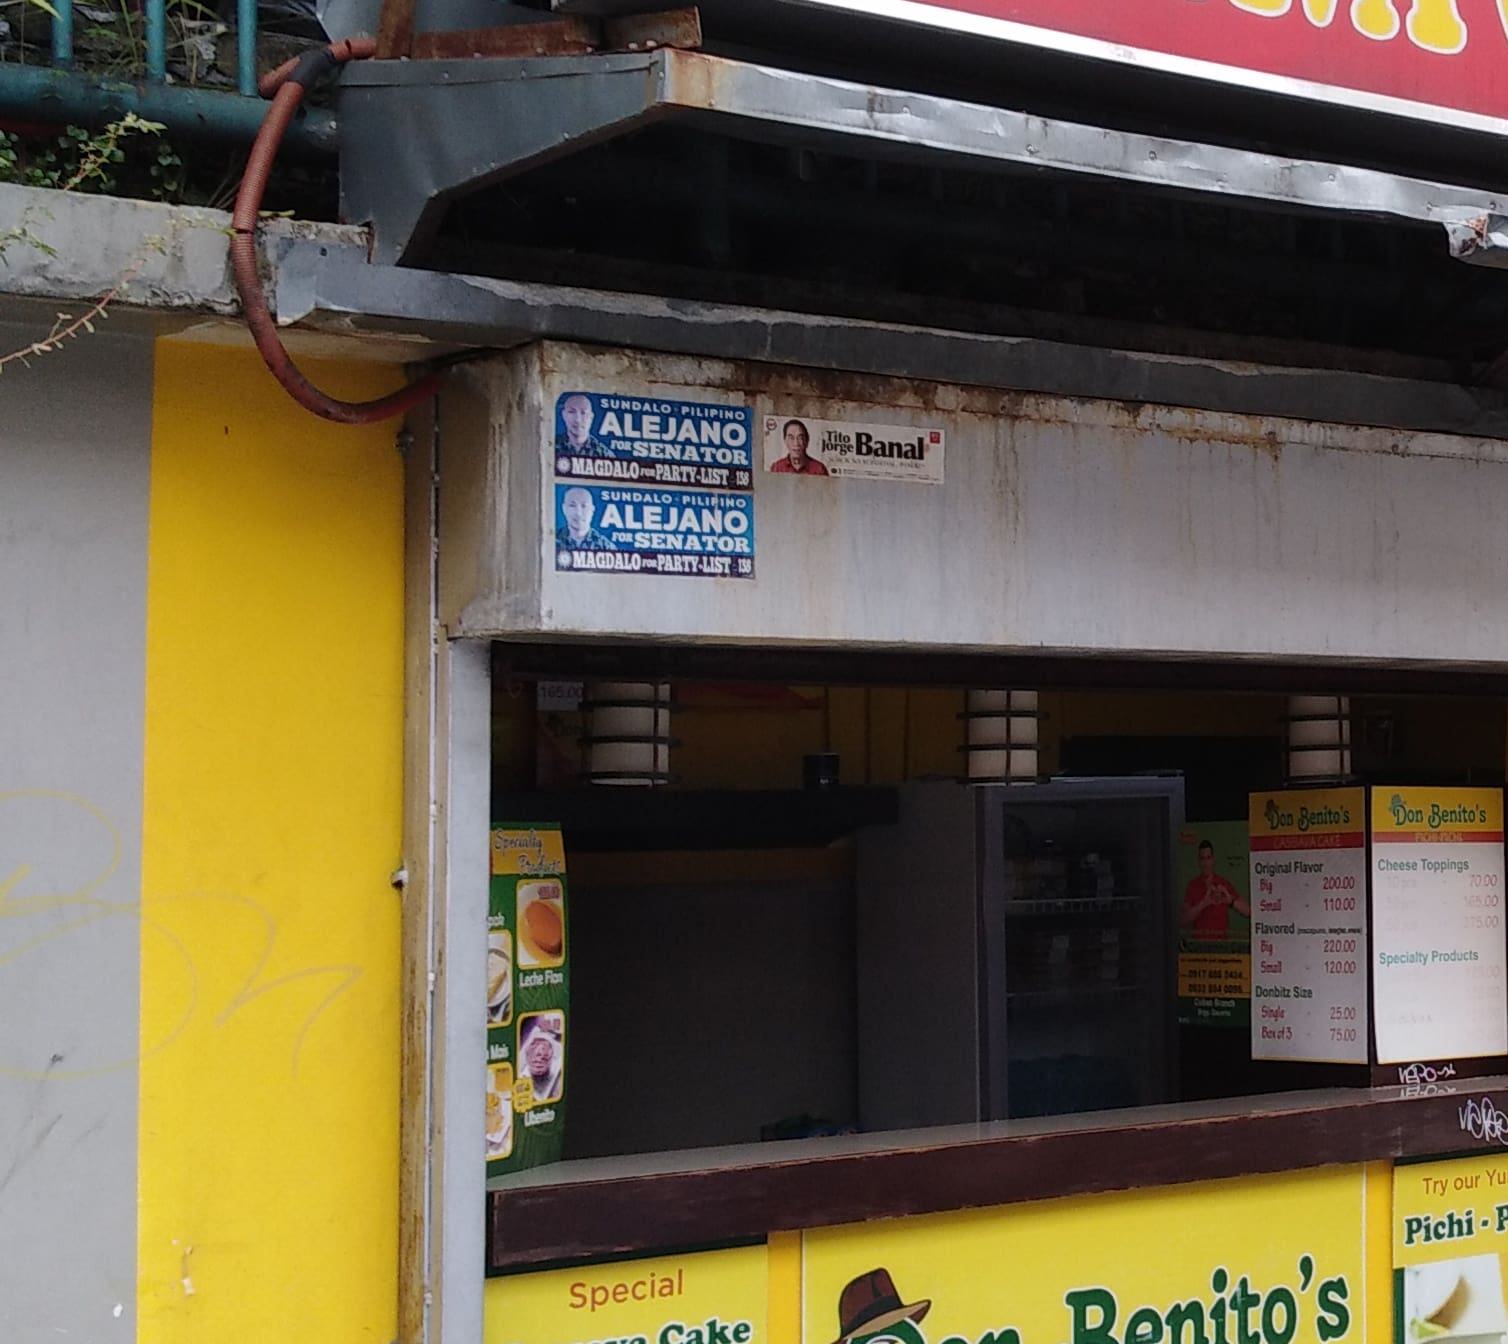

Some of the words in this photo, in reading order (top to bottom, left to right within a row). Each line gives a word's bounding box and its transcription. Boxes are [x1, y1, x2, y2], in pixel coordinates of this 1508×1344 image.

[600, 398, 672, 414] SUNDALO
[681, 406, 746, 421] PILIPINO
[599, 411, 747, 447] ALEJANO
[633, 441, 749, 465] SENATOR
[822, 439, 854, 456] Jorge
[826, 430, 850, 444] Tito
[855, 432, 924, 460] Banal
[572, 457, 639, 478] MAGDALO
[655, 464, 729, 486] PARTY-LIST
[600, 490, 672, 504] SUNDALO
[682, 495, 747, 507] PILIPINO
[600, 503, 749, 535] ALEJANO
[612, 532, 633, 543] FOR
[634, 532, 750, 552] SENATOR
[573, 551, 641, 570] MAGDALO
[657, 554, 731, 574] PARTY-LIST
[1391, 804, 1424, 826] Don
[1428, 803, 1487, 829] Benito's
[1254, 862, 1292, 877] Original
[1294, 861, 1324, 873] Flavor
[1377, 858, 1418, 871] Cheese
[1420, 858, 1470, 873] Toppings
[1323, 876, 1355, 890] 200.00
[1324, 897, 1356, 911] 110.00
[1255, 922, 1295, 935] Flavored
[1260, 940, 1273, 956] Big
[1323, 939, 1356, 953] 220.00
[1378, 952, 1429, 966] Specialty
[1431, 949, 1479, 963] Products
[1260, 960, 1282, 974] Small
[1324, 960, 1357, 974] 120.00
[519, 972, 544, 988] Leche
[1293, 986, 1313, 999] Size
[1261, 1006, 1285, 1022] Single
[1330, 1007, 1356, 1020] 25.00
[1261, 1026, 1276, 1040] Box
[1330, 1028, 1357, 1042] 75.00
[1422, 1175, 1449, 1197] Try
[1453, 1172, 1481, 1192] our
[1403, 1202, 1475, 1246] Pichi
[568, 1269, 685, 1313] Special
